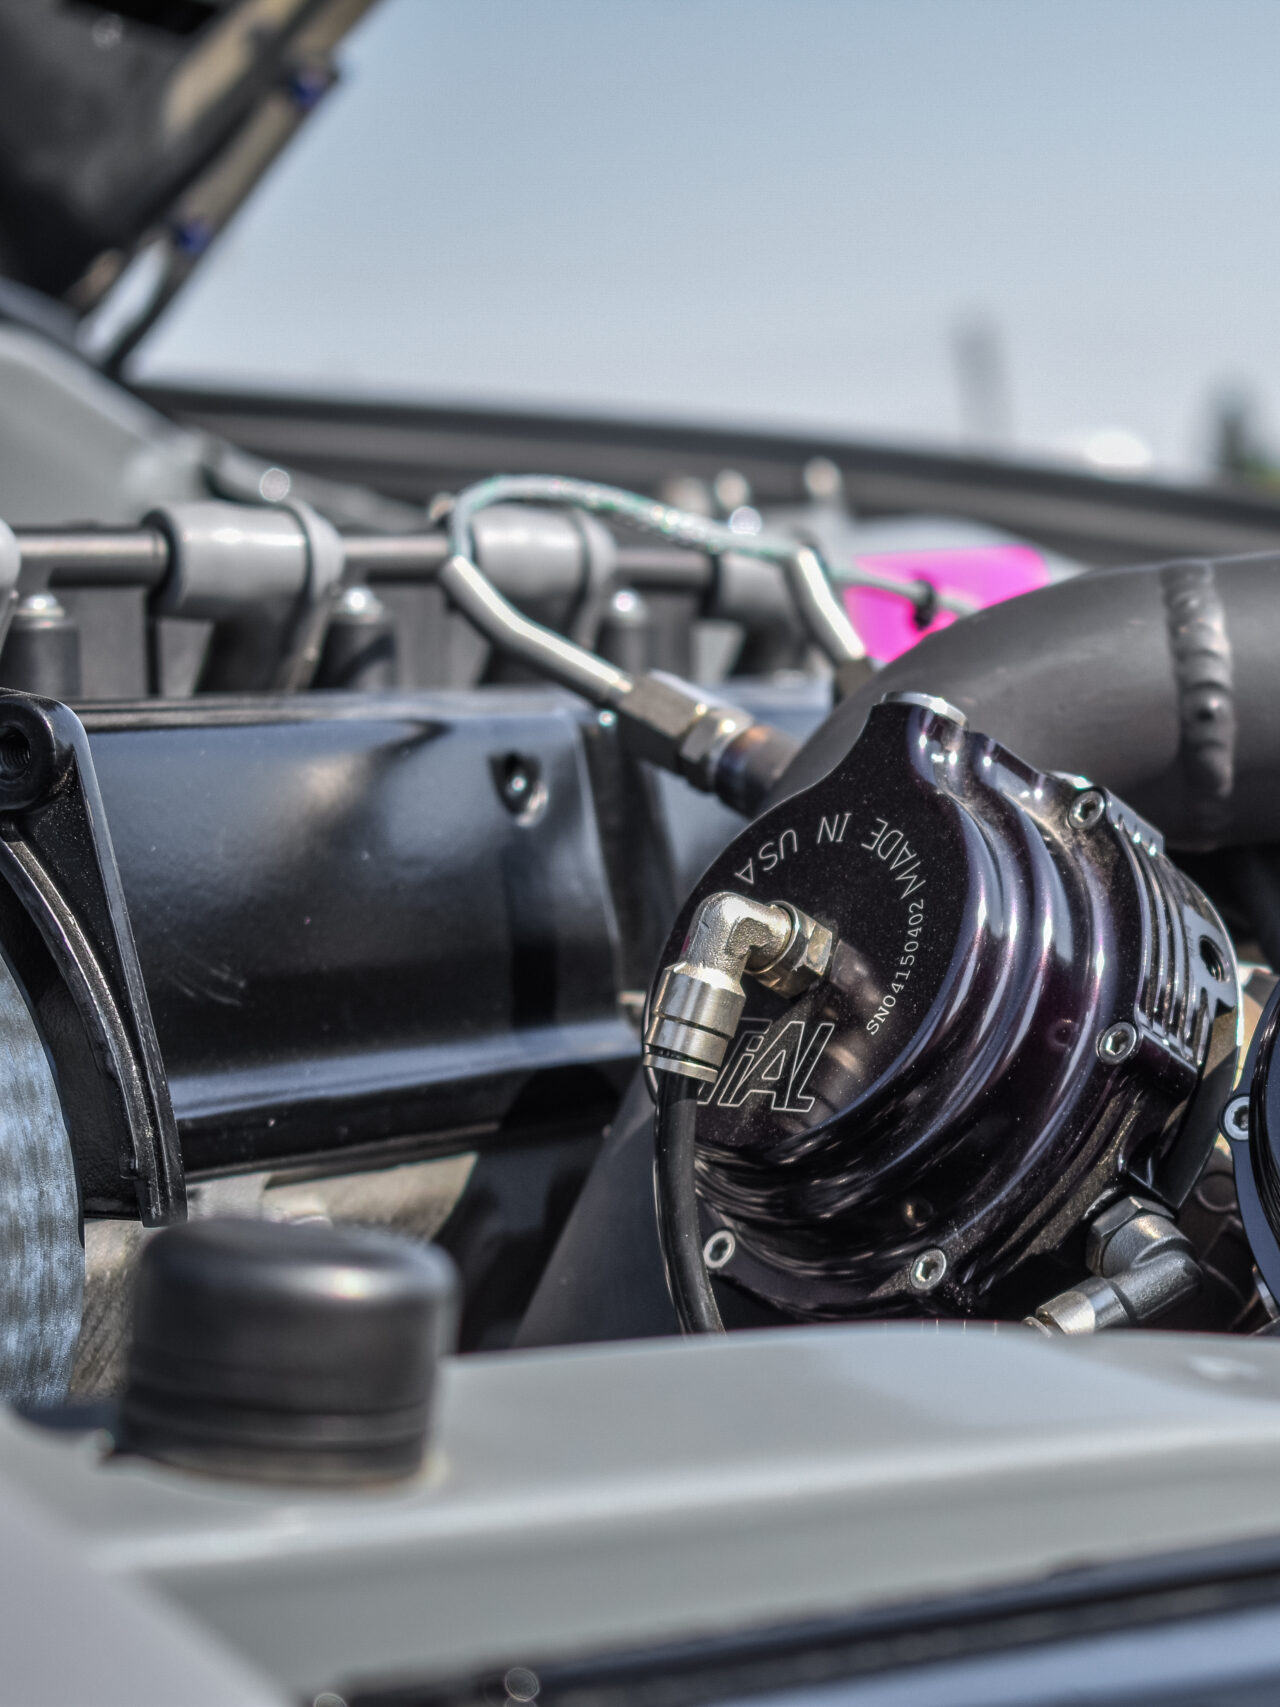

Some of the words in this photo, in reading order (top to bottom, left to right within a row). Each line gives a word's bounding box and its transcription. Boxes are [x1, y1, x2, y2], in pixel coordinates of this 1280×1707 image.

[733, 828, 799, 885] USA
[816, 812, 853, 845] IN
[860, 817, 927, 900] MADE
